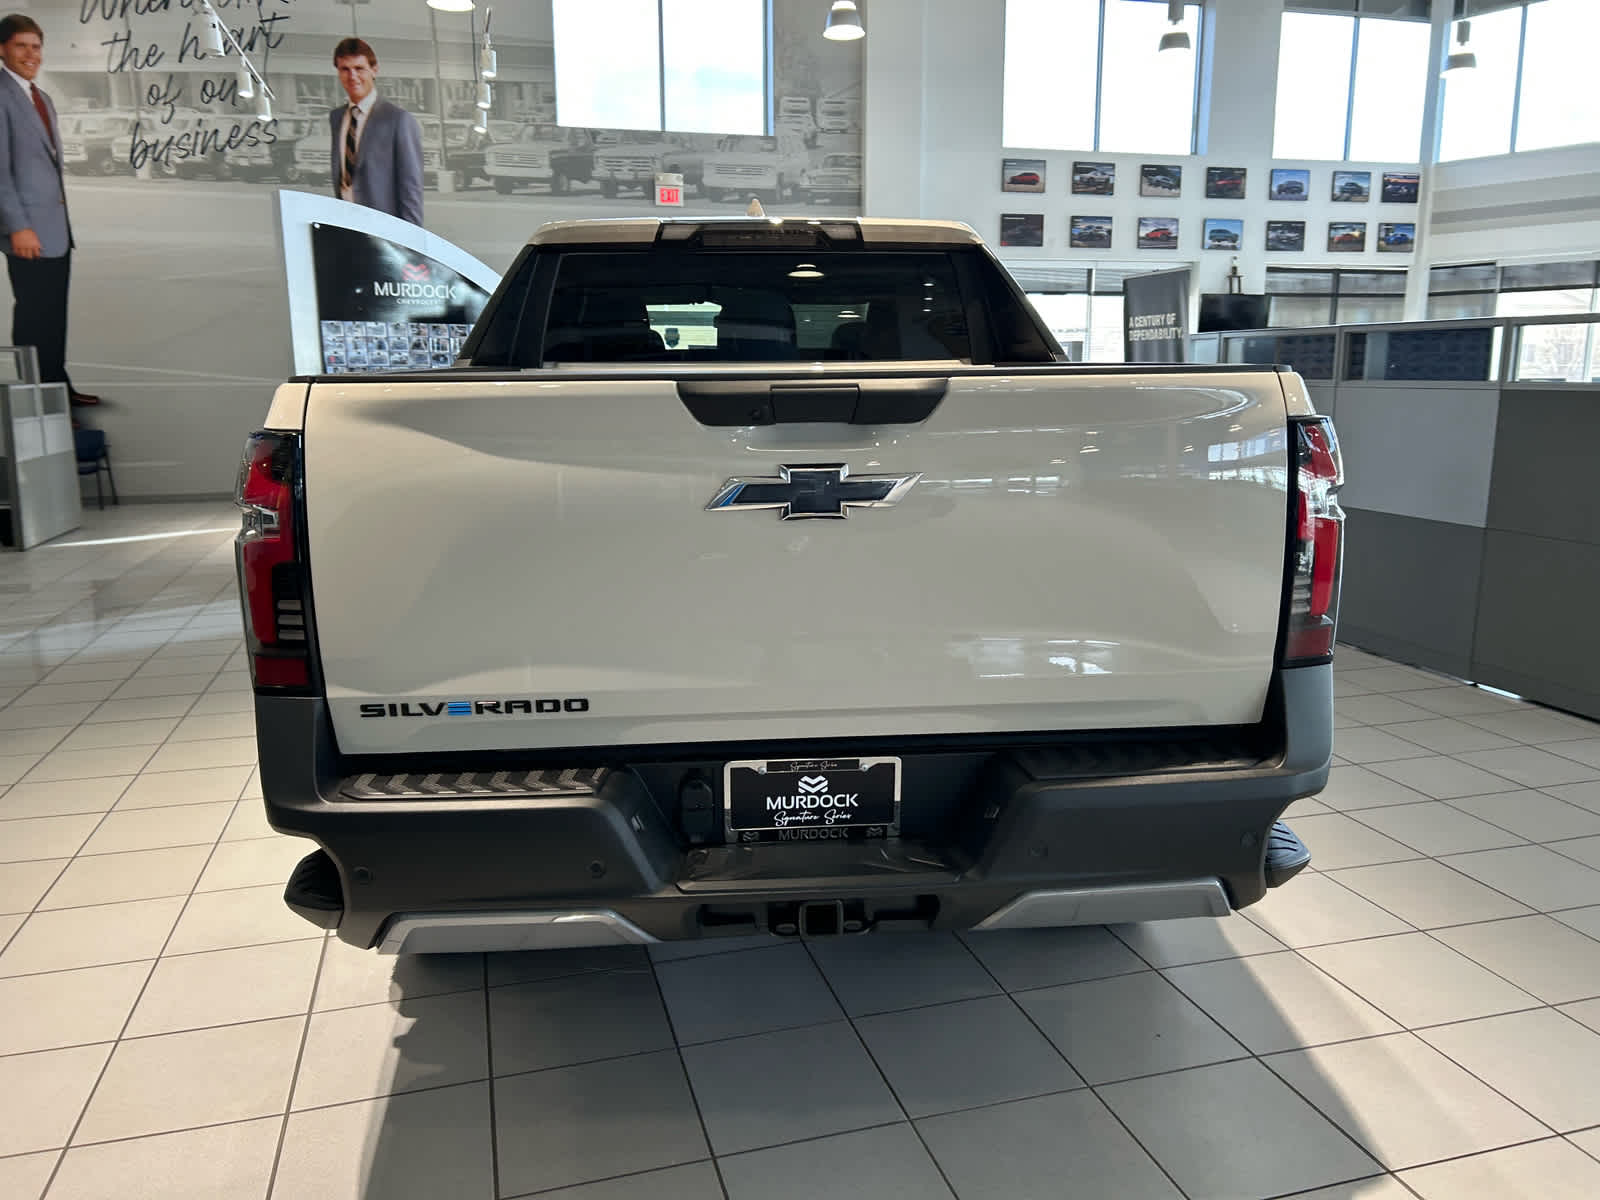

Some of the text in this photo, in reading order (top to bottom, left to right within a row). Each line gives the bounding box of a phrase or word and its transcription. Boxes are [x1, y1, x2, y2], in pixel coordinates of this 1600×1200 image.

[101, 12, 290, 73] the hart
[147, 74, 256, 124] of ou
[129, 118, 279, 169] business
[660, 188, 680, 203] EXIT
[373, 281, 457, 299] MURDOCK
[1166, 313, 1177, 325] OF
[359, 698, 589, 718] SILVERADO
[766, 793, 859, 811] MURDOCK
[773, 808, 852, 827] Signature Series
[778, 827, 849, 841] MURDOCK
